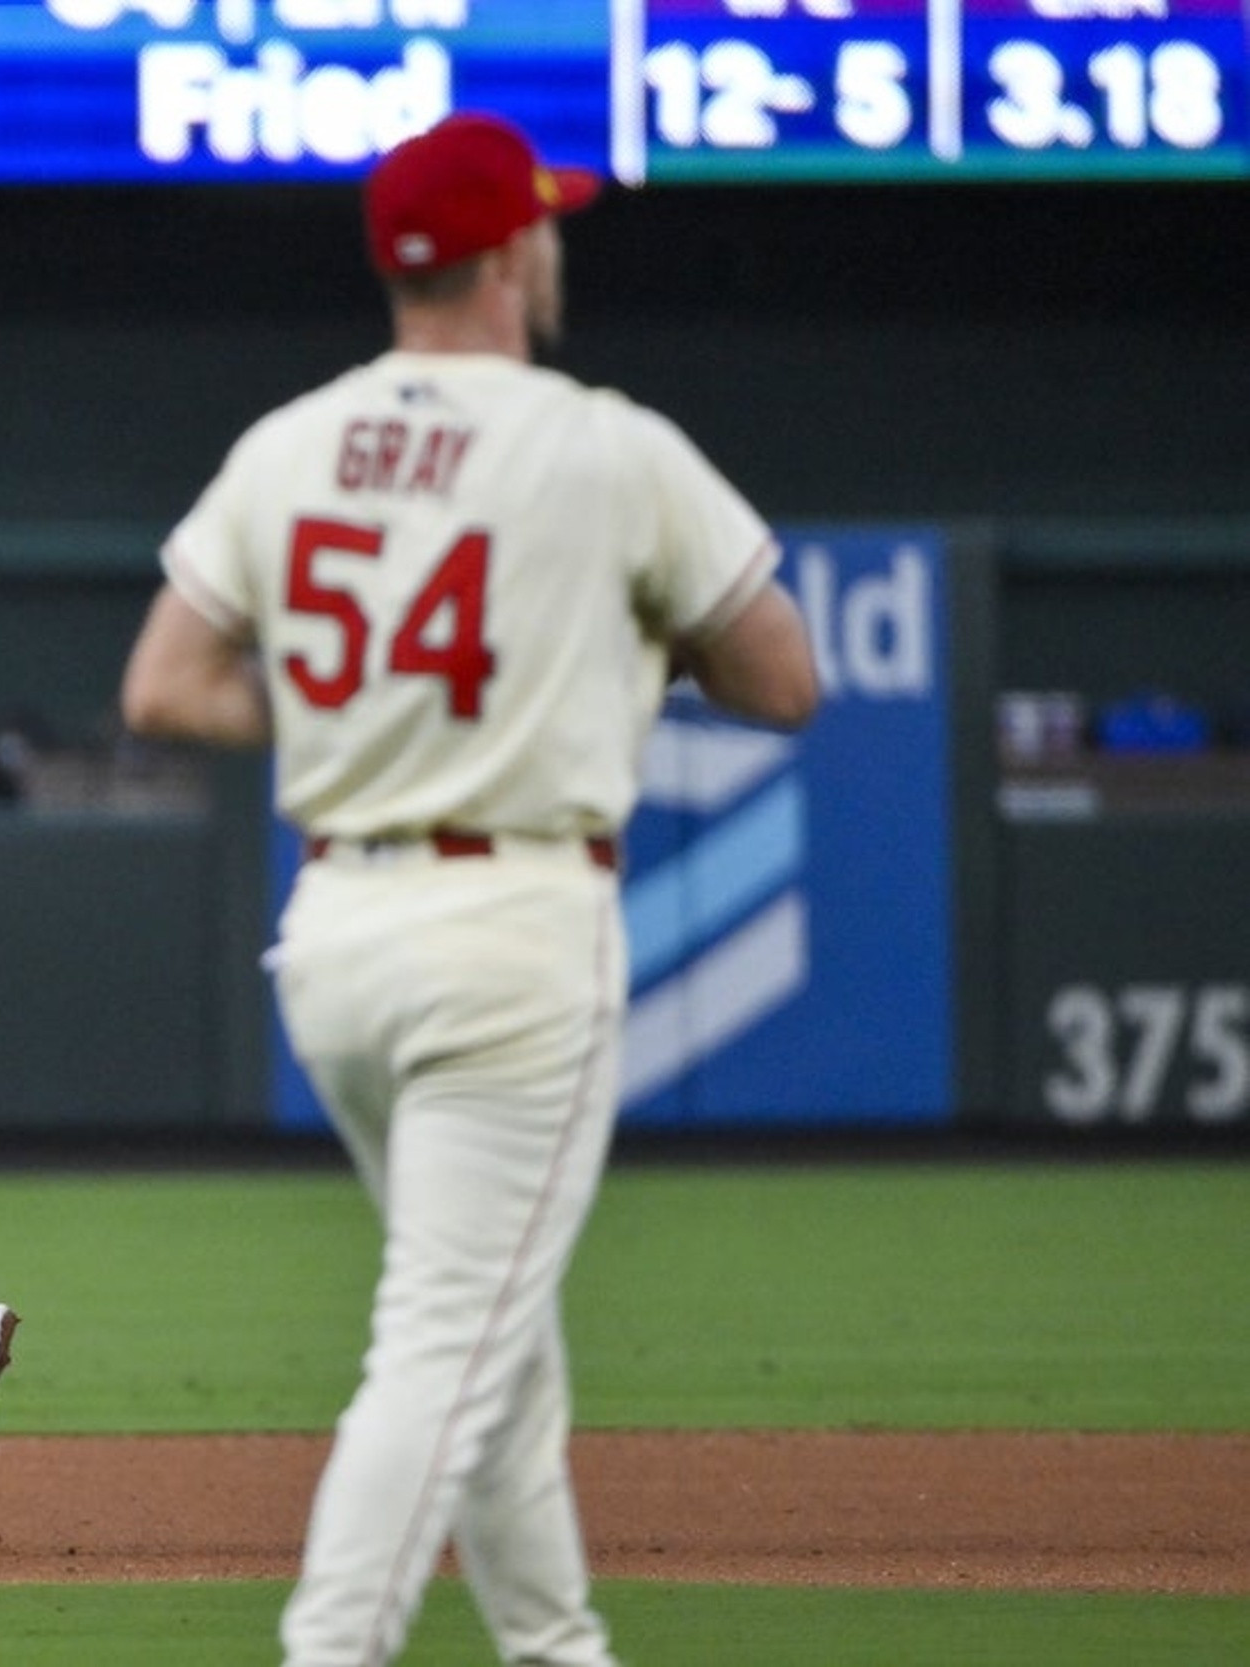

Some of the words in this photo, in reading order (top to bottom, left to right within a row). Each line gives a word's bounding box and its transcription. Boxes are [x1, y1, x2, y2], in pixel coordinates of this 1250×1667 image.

[138, 38, 452, 164] Fried
[986, 39, 1224, 150] 3.18
[336, 417, 478, 497] GRAY
[283, 516, 497, 722] 54
[1046, 985, 1250, 1122] 375
